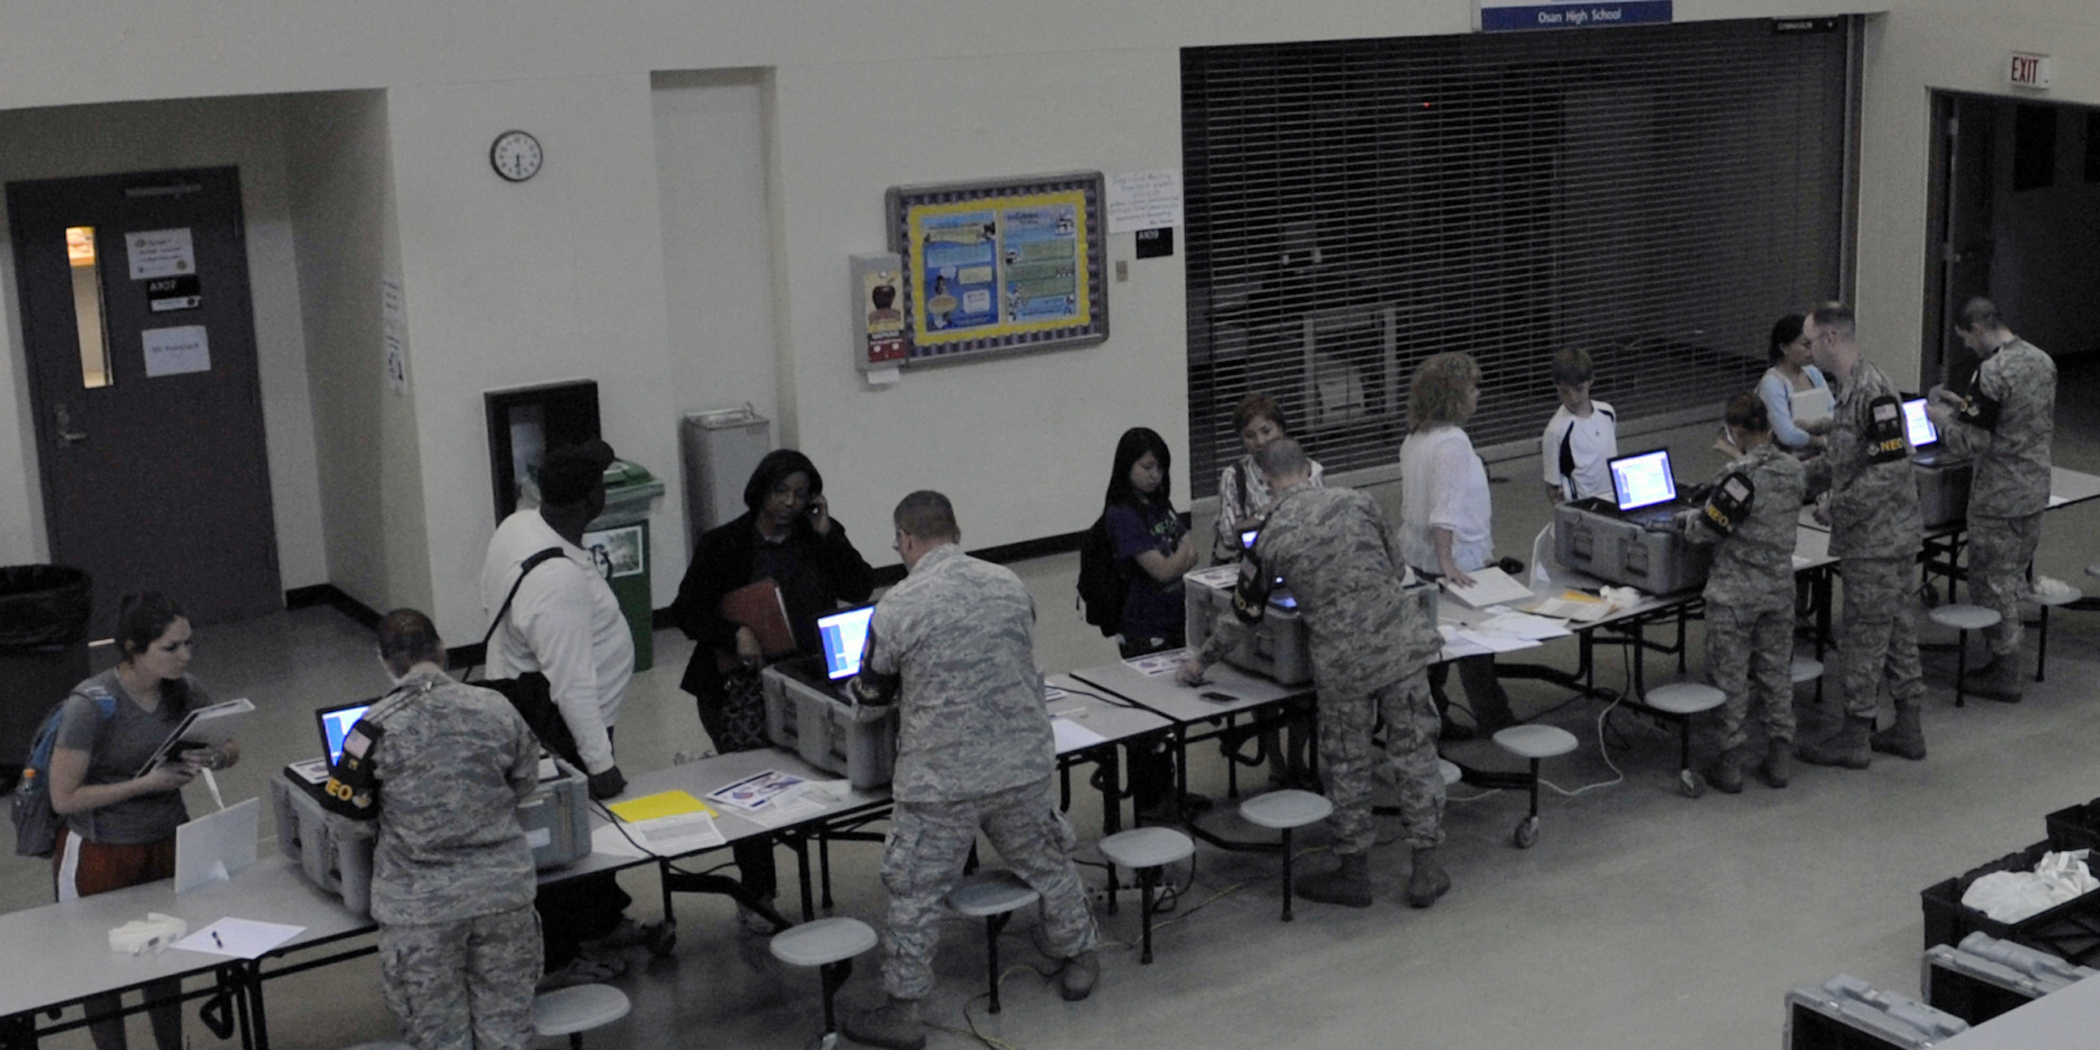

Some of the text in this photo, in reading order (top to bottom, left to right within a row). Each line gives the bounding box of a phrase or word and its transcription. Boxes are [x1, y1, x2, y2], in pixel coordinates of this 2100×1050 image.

[1537, 8, 1622, 24] Osan High School
[2011, 56, 2039, 84] EXIT
